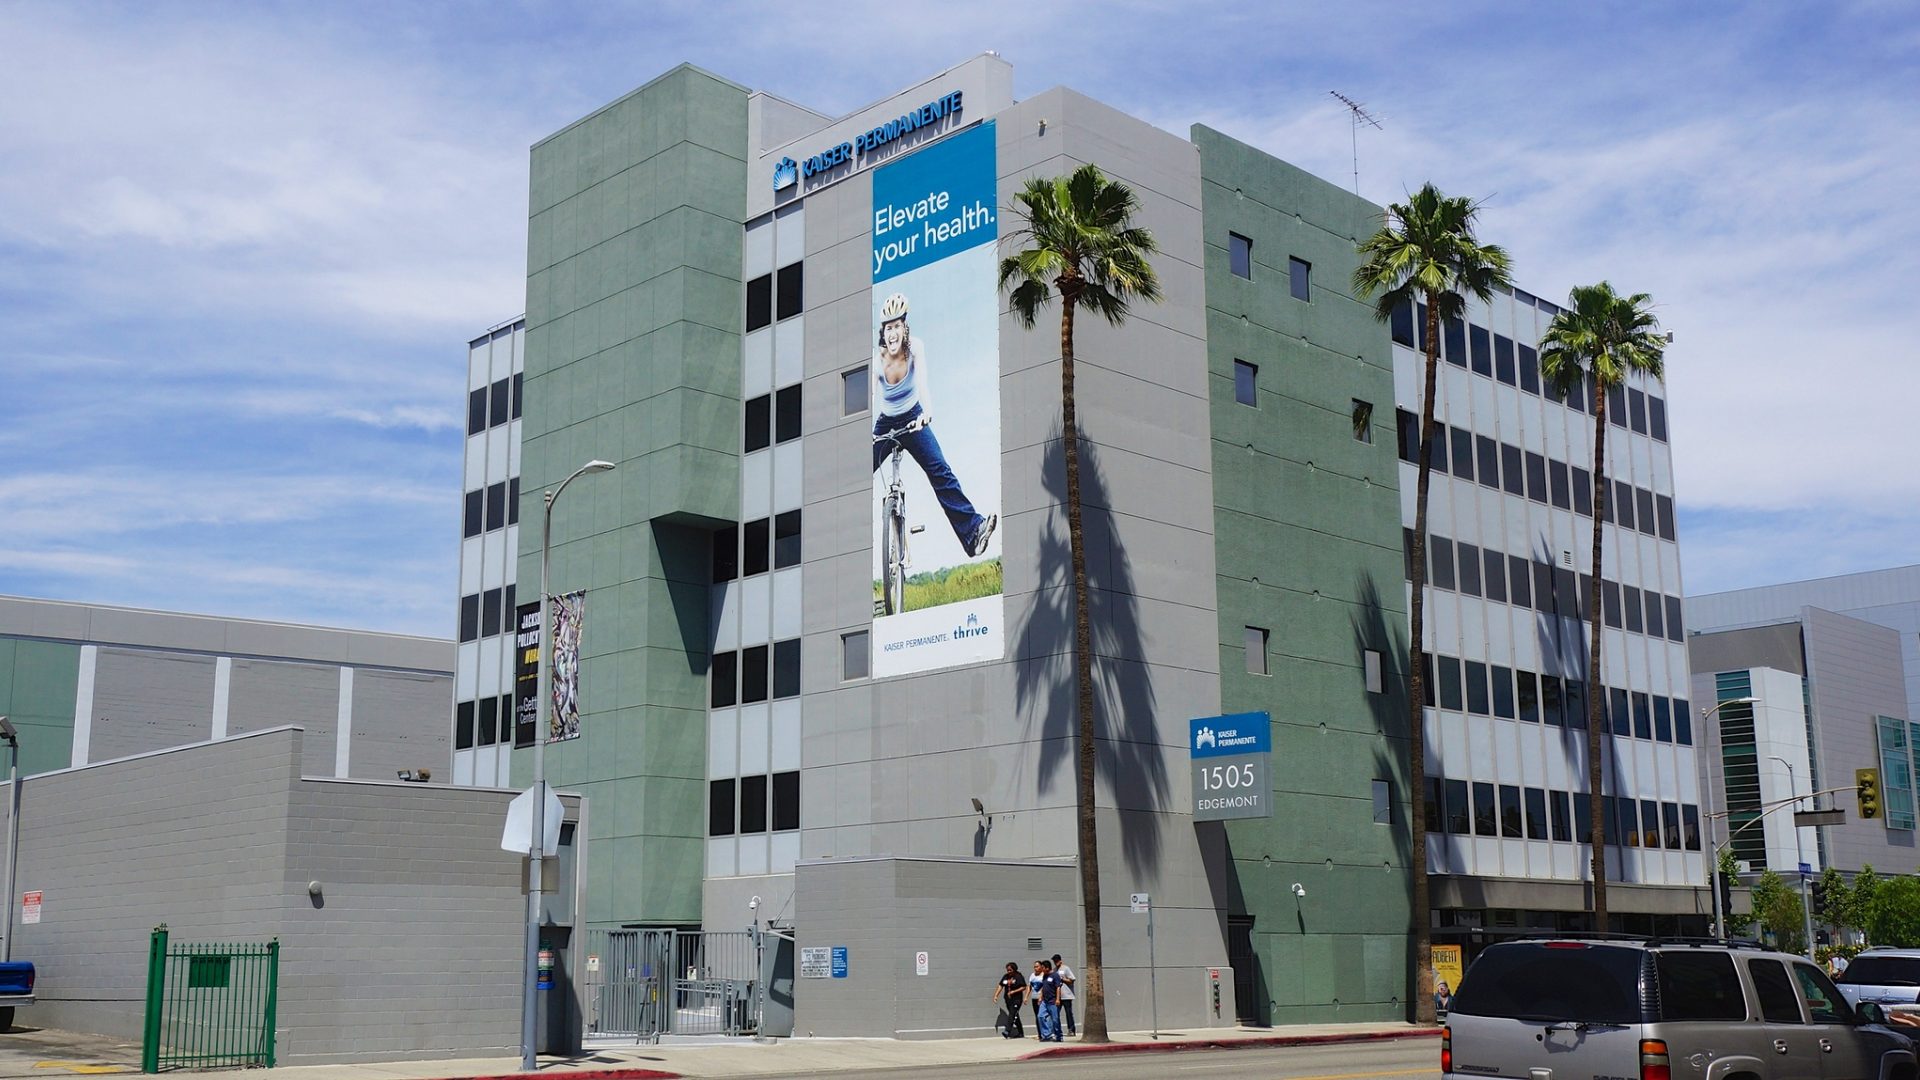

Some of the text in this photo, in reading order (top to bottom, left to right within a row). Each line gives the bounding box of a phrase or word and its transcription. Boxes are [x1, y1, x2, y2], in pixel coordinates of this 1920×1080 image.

[801, 90, 963, 178] KAISER PERMANENTE
[875, 191, 949, 236] Elevate
[874, 201, 996, 275] your health.
[953, 625, 989, 640] thrive
[884, 641, 905, 652] KAISER
[523, 696, 537, 712] Gett
[1218, 730, 1237, 739] KAISER
[1219, 737, 1256, 747] PERMANENTE
[1201, 763, 1255, 791] 1505
[1198, 795, 1259, 810] EDGEMONT
